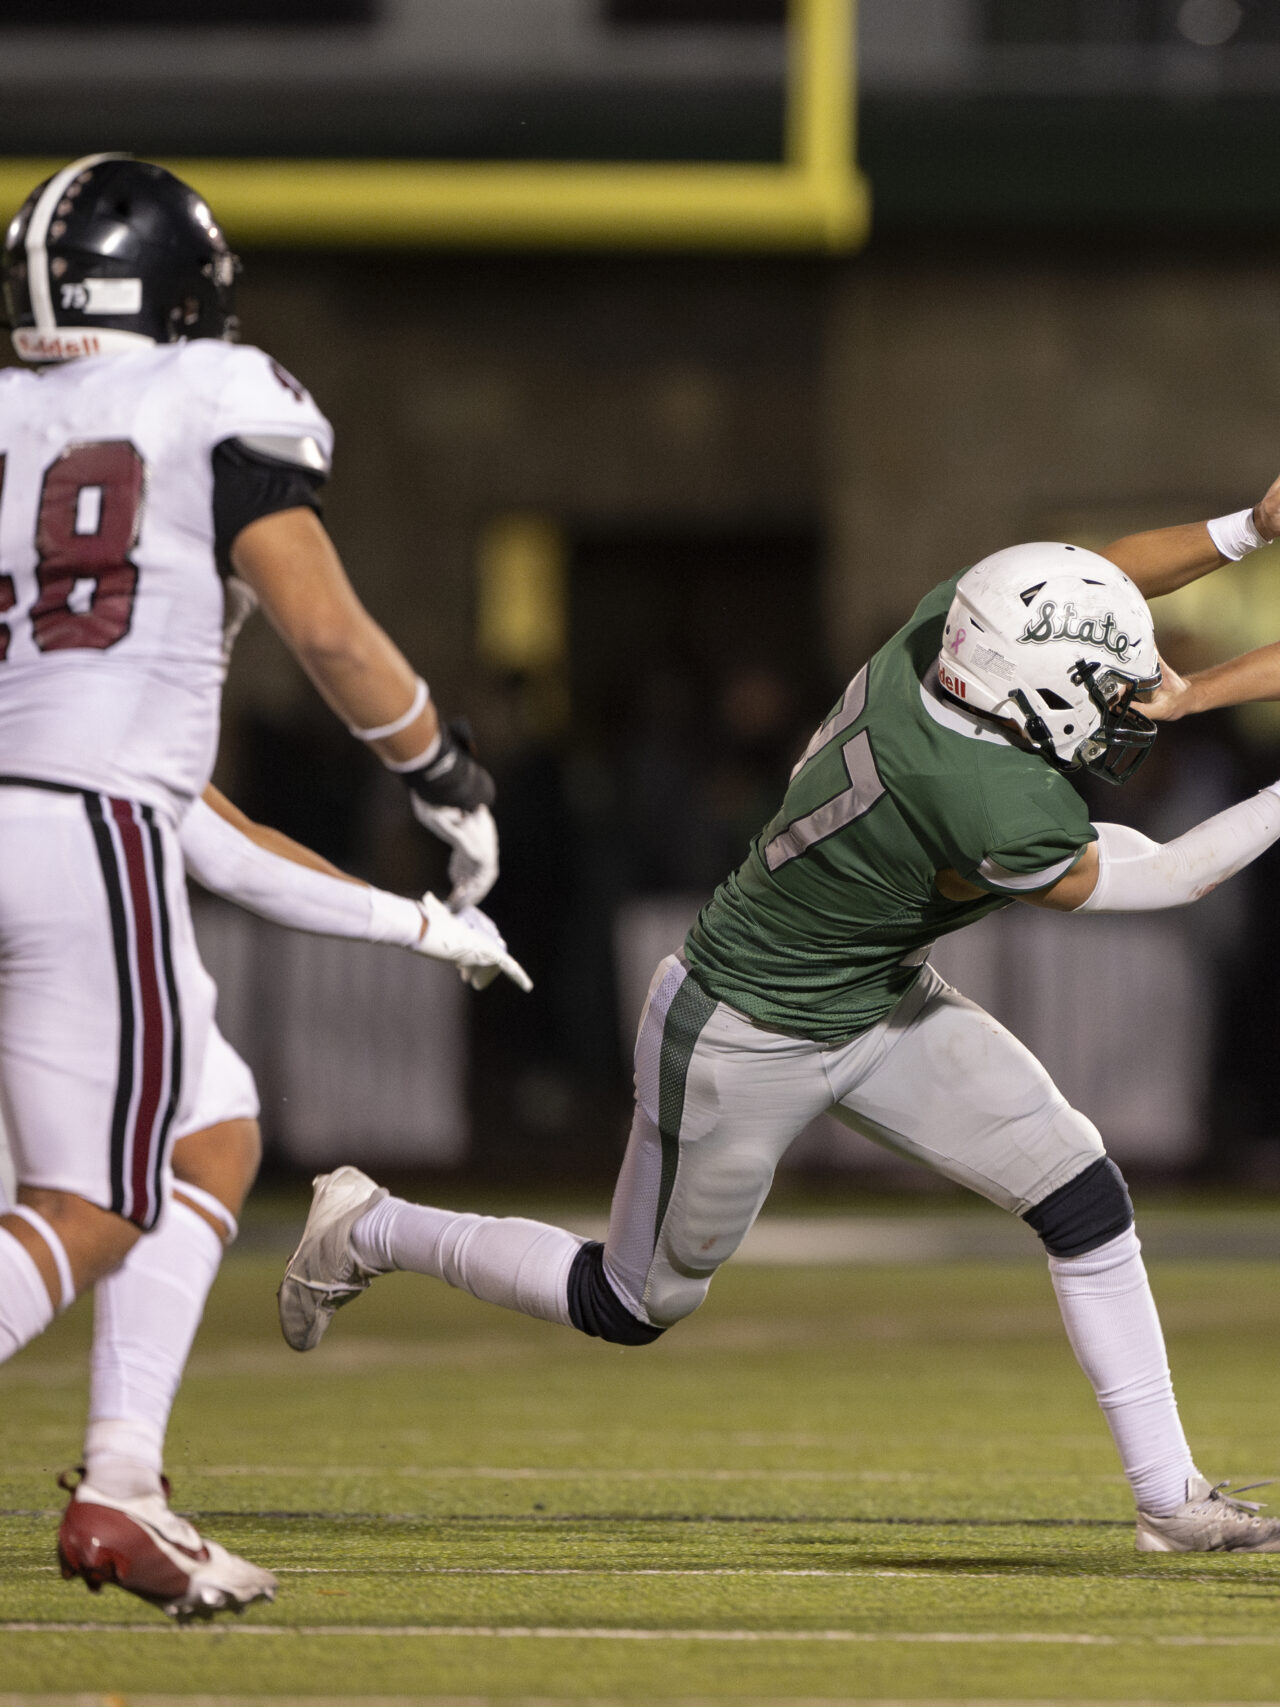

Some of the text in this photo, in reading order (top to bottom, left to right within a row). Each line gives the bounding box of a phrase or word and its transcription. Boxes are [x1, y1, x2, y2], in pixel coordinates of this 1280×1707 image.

[19, 335, 99, 357] ddell
[0, 440, 147, 653] 8
[1016, 600, 1131, 663] State
[938, 667, 966, 698] dell
